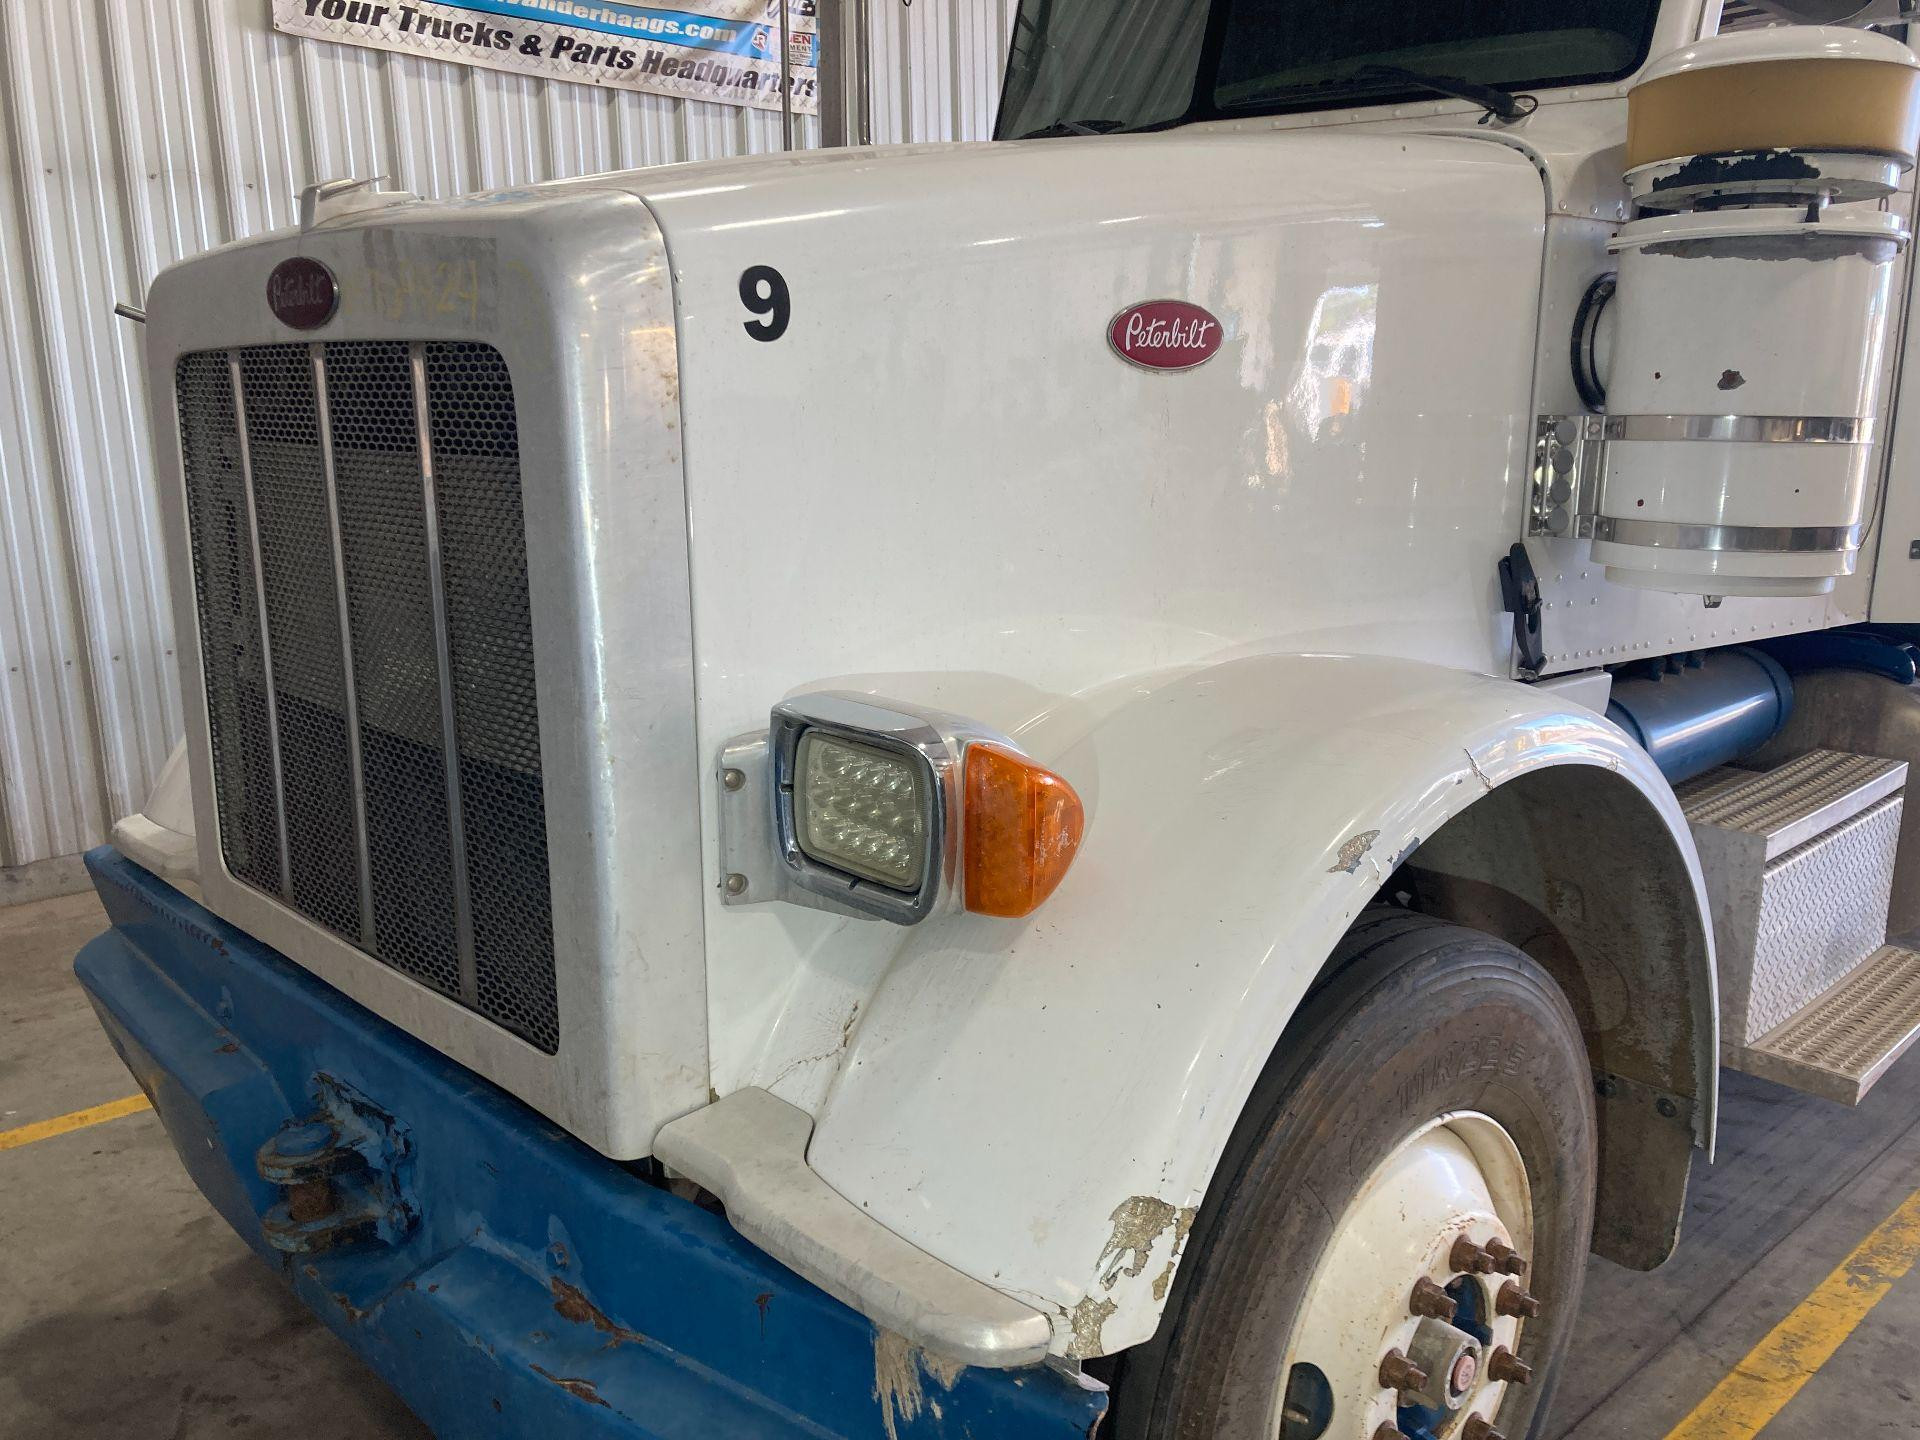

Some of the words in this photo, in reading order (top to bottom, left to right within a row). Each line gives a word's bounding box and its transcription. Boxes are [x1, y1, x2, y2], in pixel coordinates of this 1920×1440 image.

[304, 0, 390, 27] Your
[398, 5, 514, 51] Trucks
[518, 34, 544, 57] &
[550, 35, 637, 70] Parts
[738, 264, 791, 343] 9
[1125, 312, 1215, 351] Peterbilt
